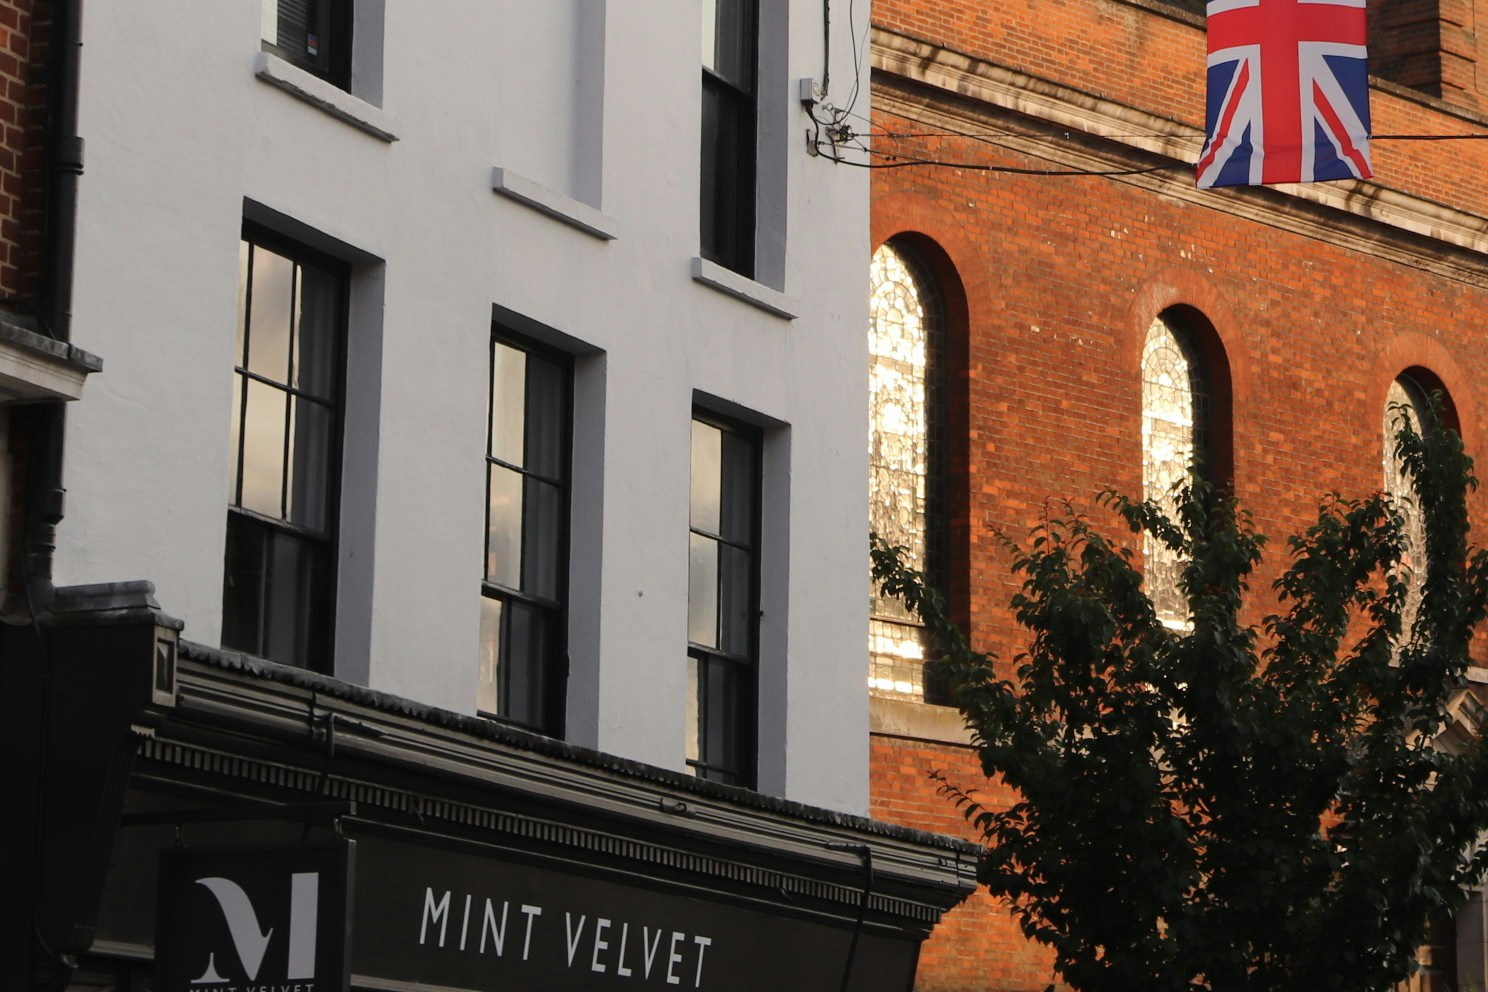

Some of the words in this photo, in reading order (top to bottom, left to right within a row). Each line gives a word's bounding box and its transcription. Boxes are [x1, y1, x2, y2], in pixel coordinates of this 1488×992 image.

[190, 872, 319, 984] M
[419, 887, 542, 961] MINT
[565, 912, 712, 988] VELVET
